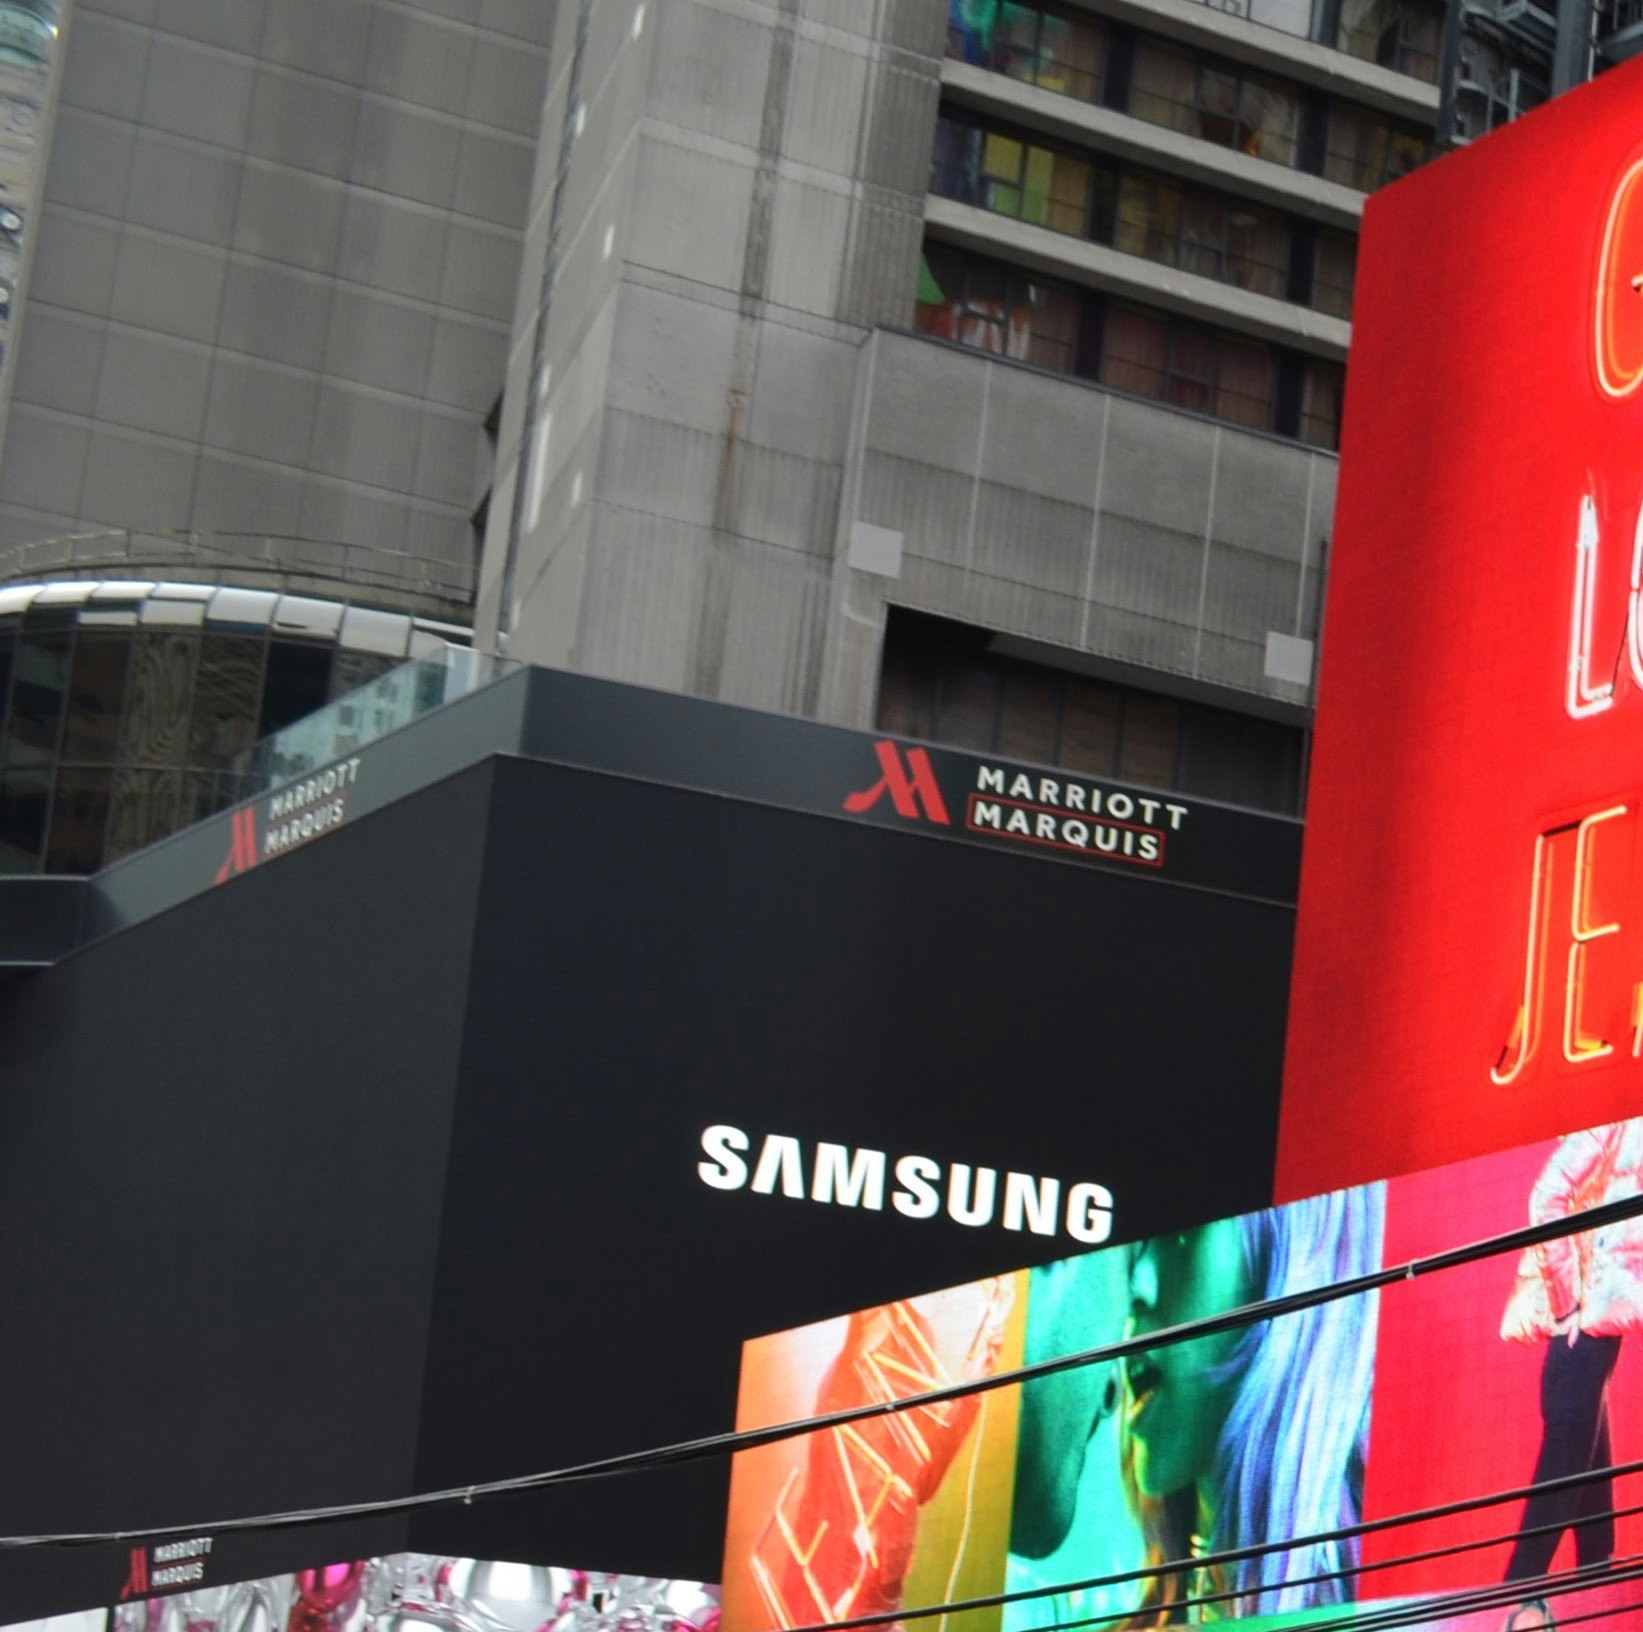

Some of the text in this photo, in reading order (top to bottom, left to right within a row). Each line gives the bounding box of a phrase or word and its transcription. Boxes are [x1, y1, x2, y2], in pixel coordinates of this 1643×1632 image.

[269, 757, 361, 819] MARRIOTT
[976, 764, 1188, 831] MARRIOTT
[263, 800, 346, 854] MARQUIS
[973, 801, 1160, 861] MARQUIS
[697, 1124, 1114, 1244] SAMSUNG
[151, 1561, 204, 1586] MARQUIS
[153, 1538, 212, 1565] MARRIOTT
